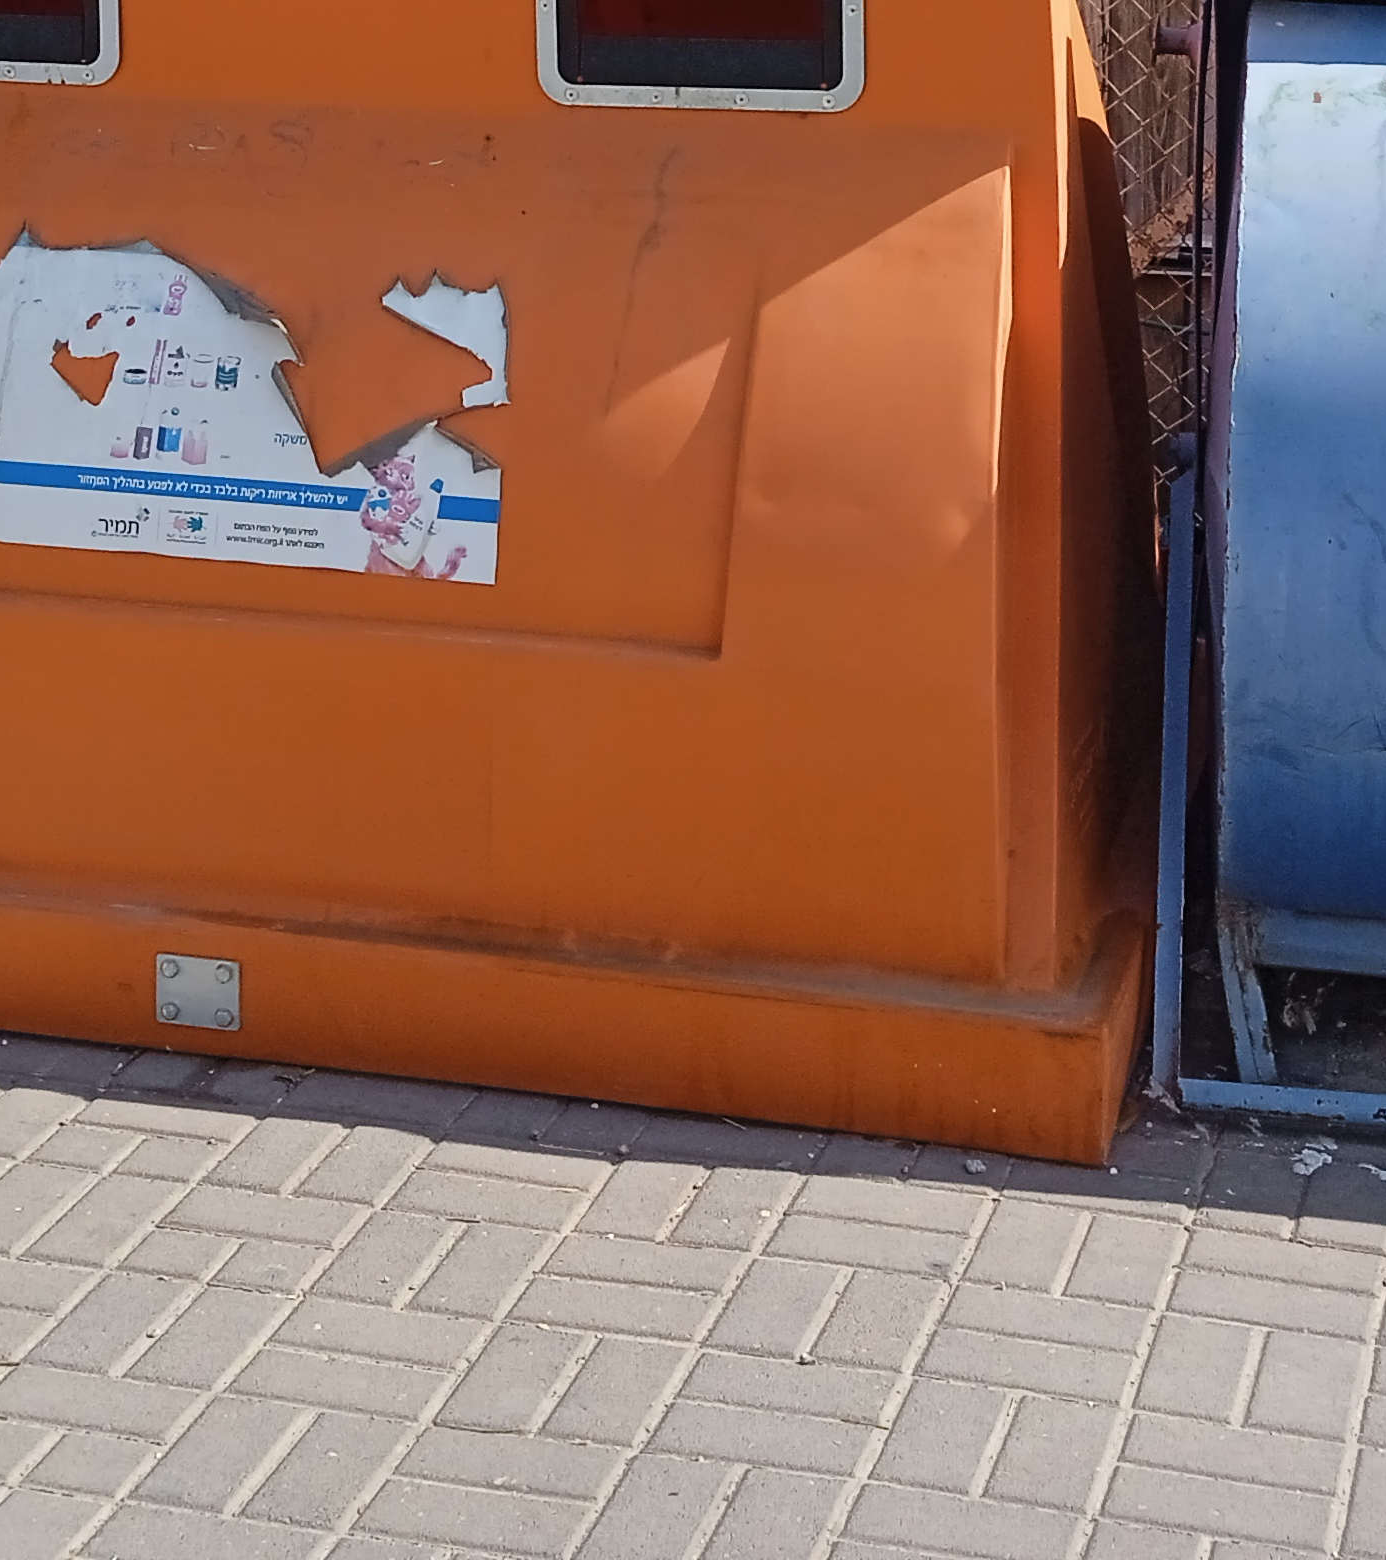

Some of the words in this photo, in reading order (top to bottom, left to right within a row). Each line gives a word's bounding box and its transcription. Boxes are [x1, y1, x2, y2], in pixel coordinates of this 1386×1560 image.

[175, 481, 188, 492] לא
[213, 483, 238, 496] בלבד
[268, 488, 297, 501] אריזות
[299, 490, 334, 504] להשליך
[336, 495, 348, 505] יש
[97, 517, 140, 535] תמיר
